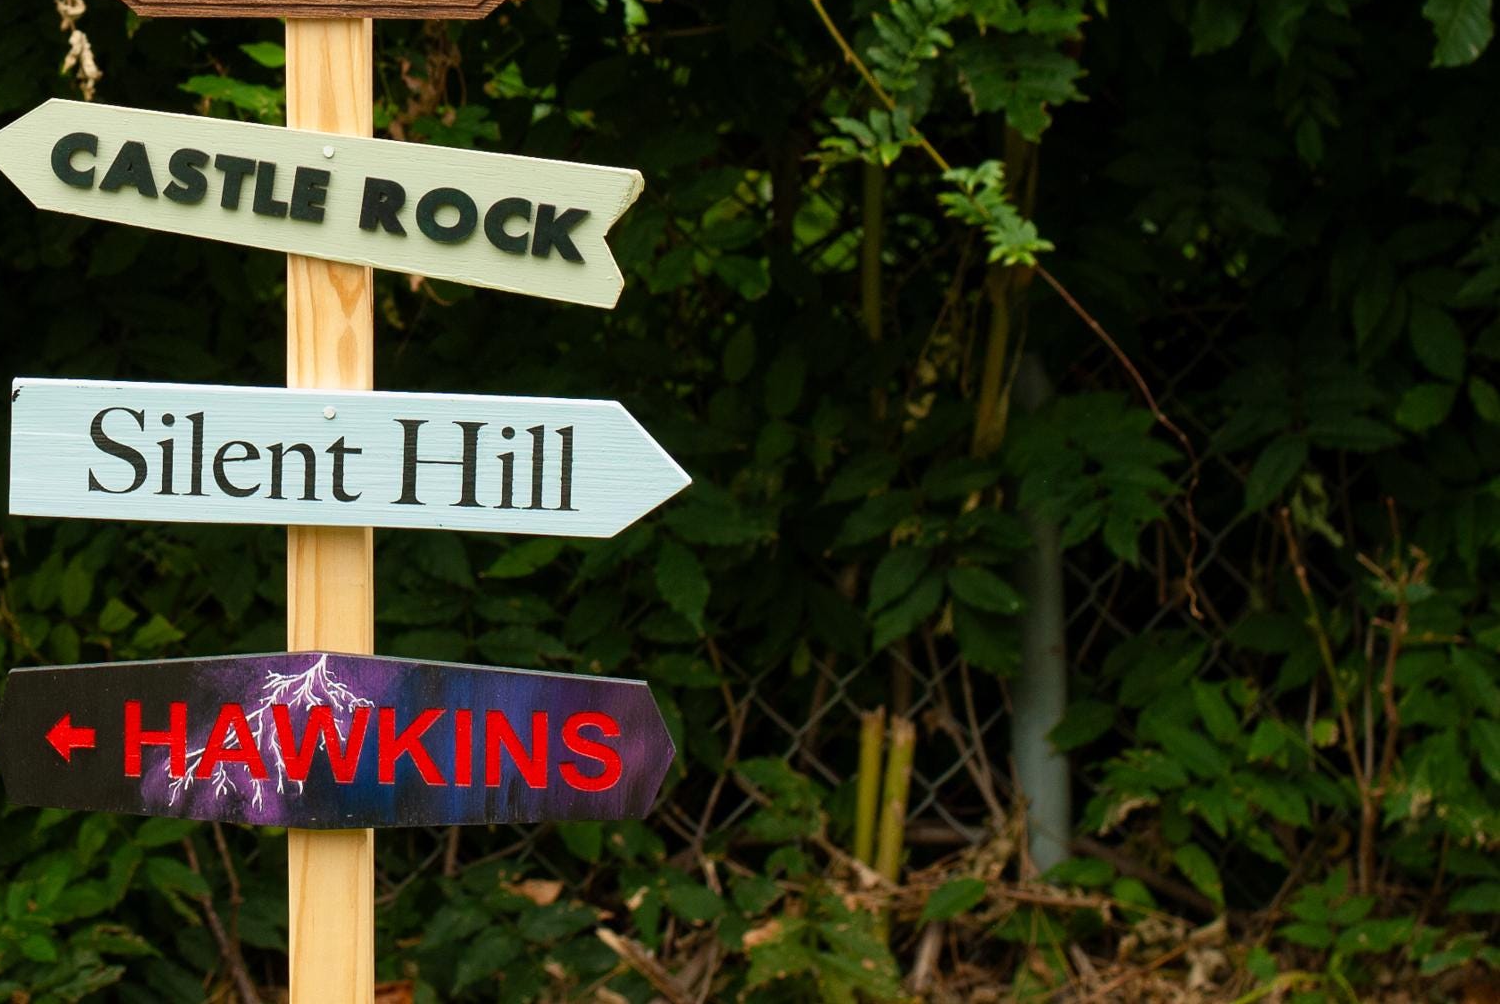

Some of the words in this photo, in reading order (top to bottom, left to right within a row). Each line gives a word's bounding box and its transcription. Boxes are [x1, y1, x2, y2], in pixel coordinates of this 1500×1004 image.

[50, 131, 332, 225] CASTLE
[358, 175, 592, 266] ROCK
[88, 406, 363, 503] Silent
[390, 417, 580, 513] Hill
[123, 698, 624, 793] HAWKINS
